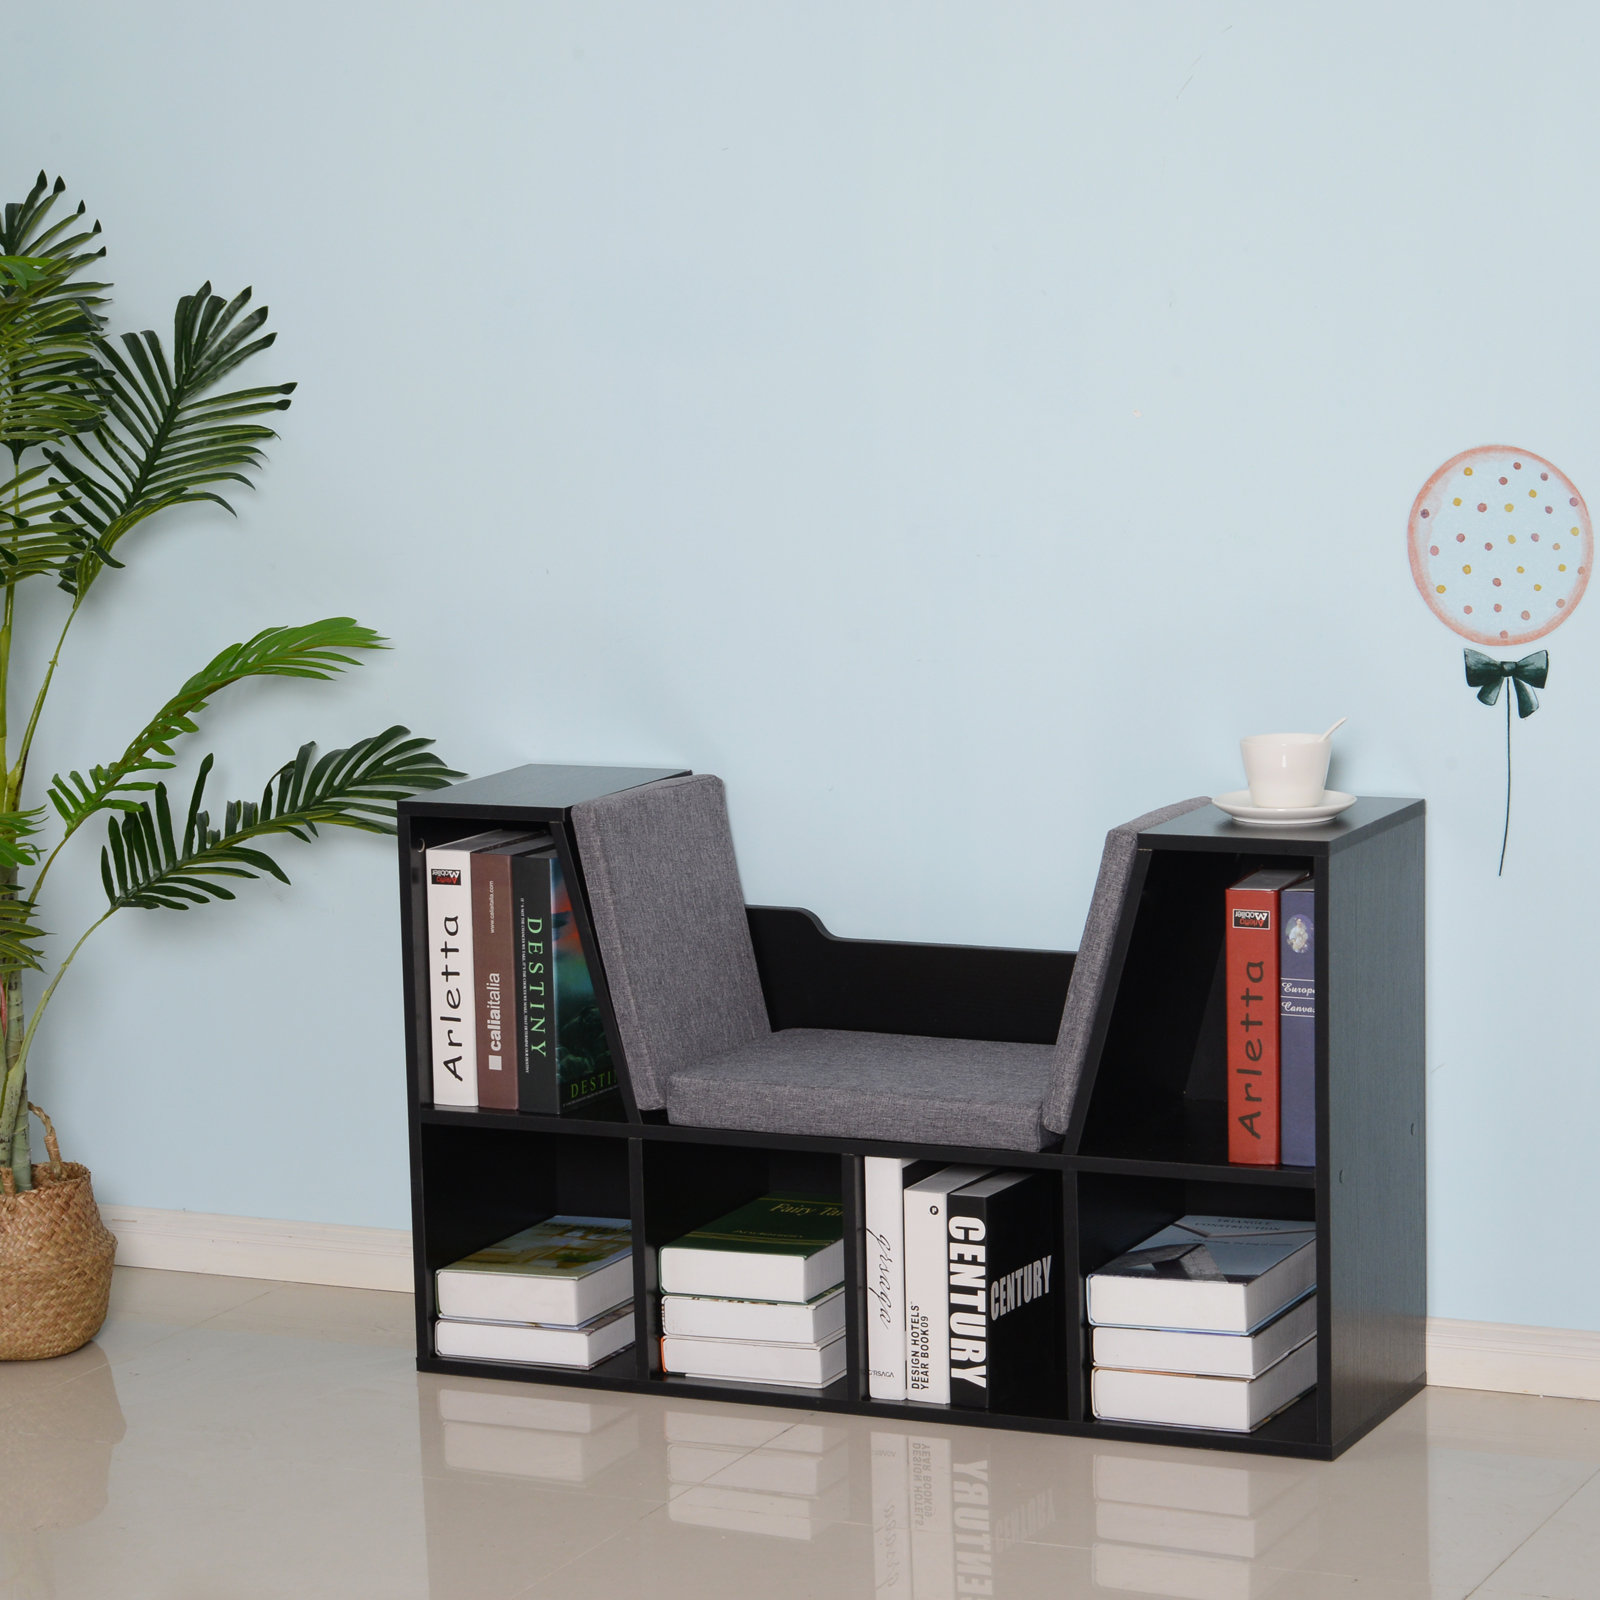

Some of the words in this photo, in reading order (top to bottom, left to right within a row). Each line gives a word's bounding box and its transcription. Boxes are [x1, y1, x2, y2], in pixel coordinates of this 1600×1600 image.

[440, 915, 463, 1082] Arletta
[486, 972, 501, 1052] caliaitalia
[527, 916, 547, 1058] DESTINY
[1236, 960, 1264, 1140] Arletta
[770, 1203, 814, 1217] Fairy
[948, 1216, 987, 1389] CENTURY
[991, 1255, 1052, 1321] CENTURY
[911, 1350, 920, 1389] DESIGN
[920, 1362, 929, 1390] YEAR
